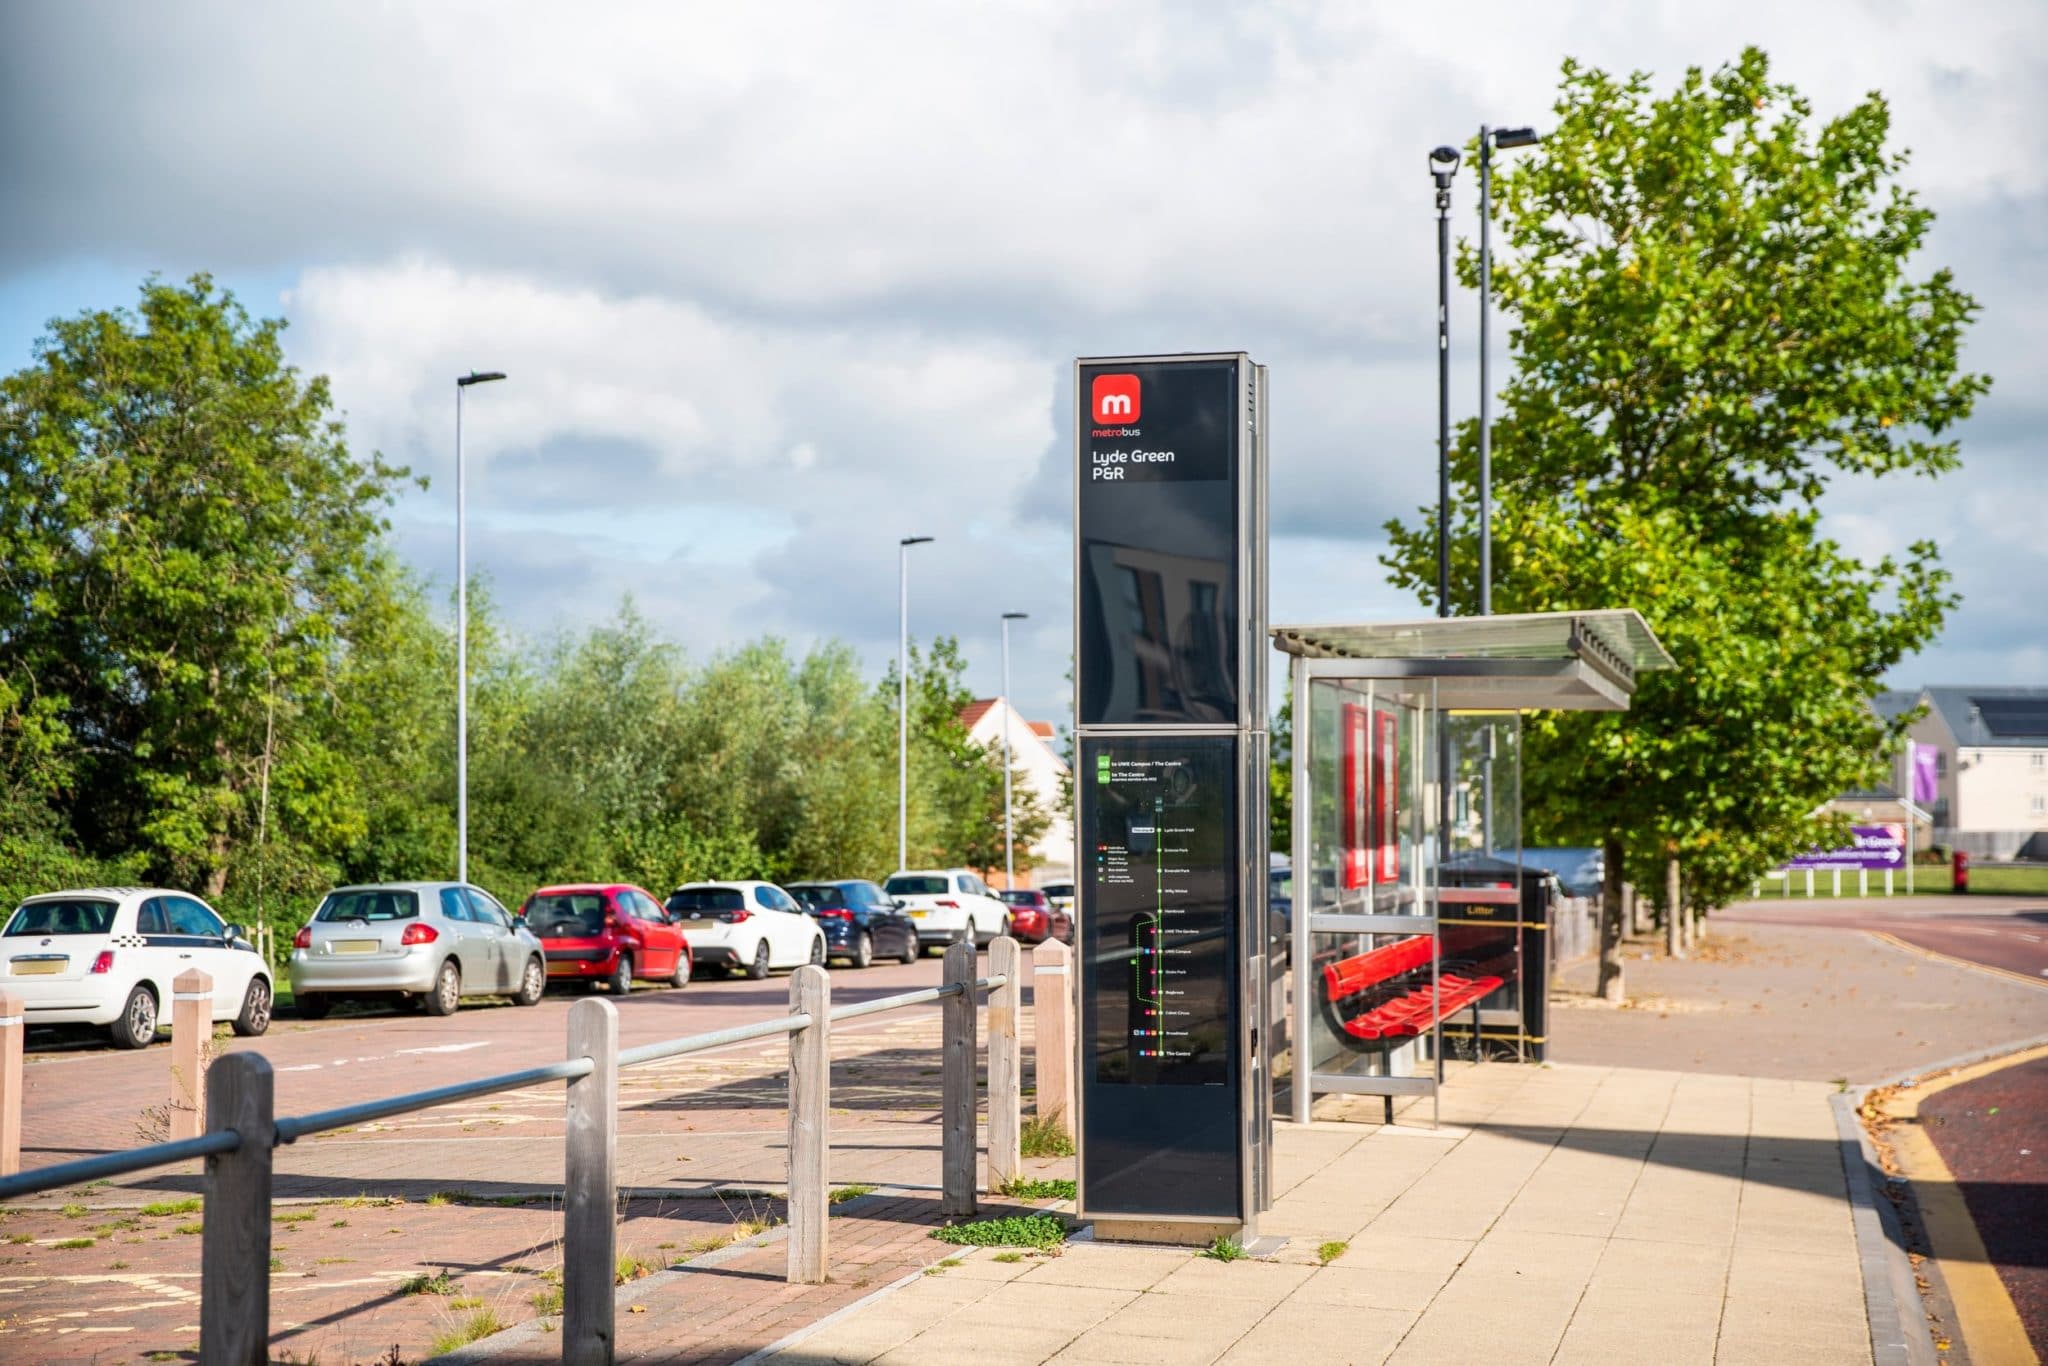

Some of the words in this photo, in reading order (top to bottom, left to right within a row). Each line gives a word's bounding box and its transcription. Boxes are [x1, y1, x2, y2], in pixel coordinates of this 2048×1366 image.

[1101, 394, 1131, 415] m
[1092, 427, 1141, 438] metrobus
[1092, 450, 1128, 467] Lyde
[1131, 450, 1175, 463] Green
[1092, 467, 1125, 480] P&R
